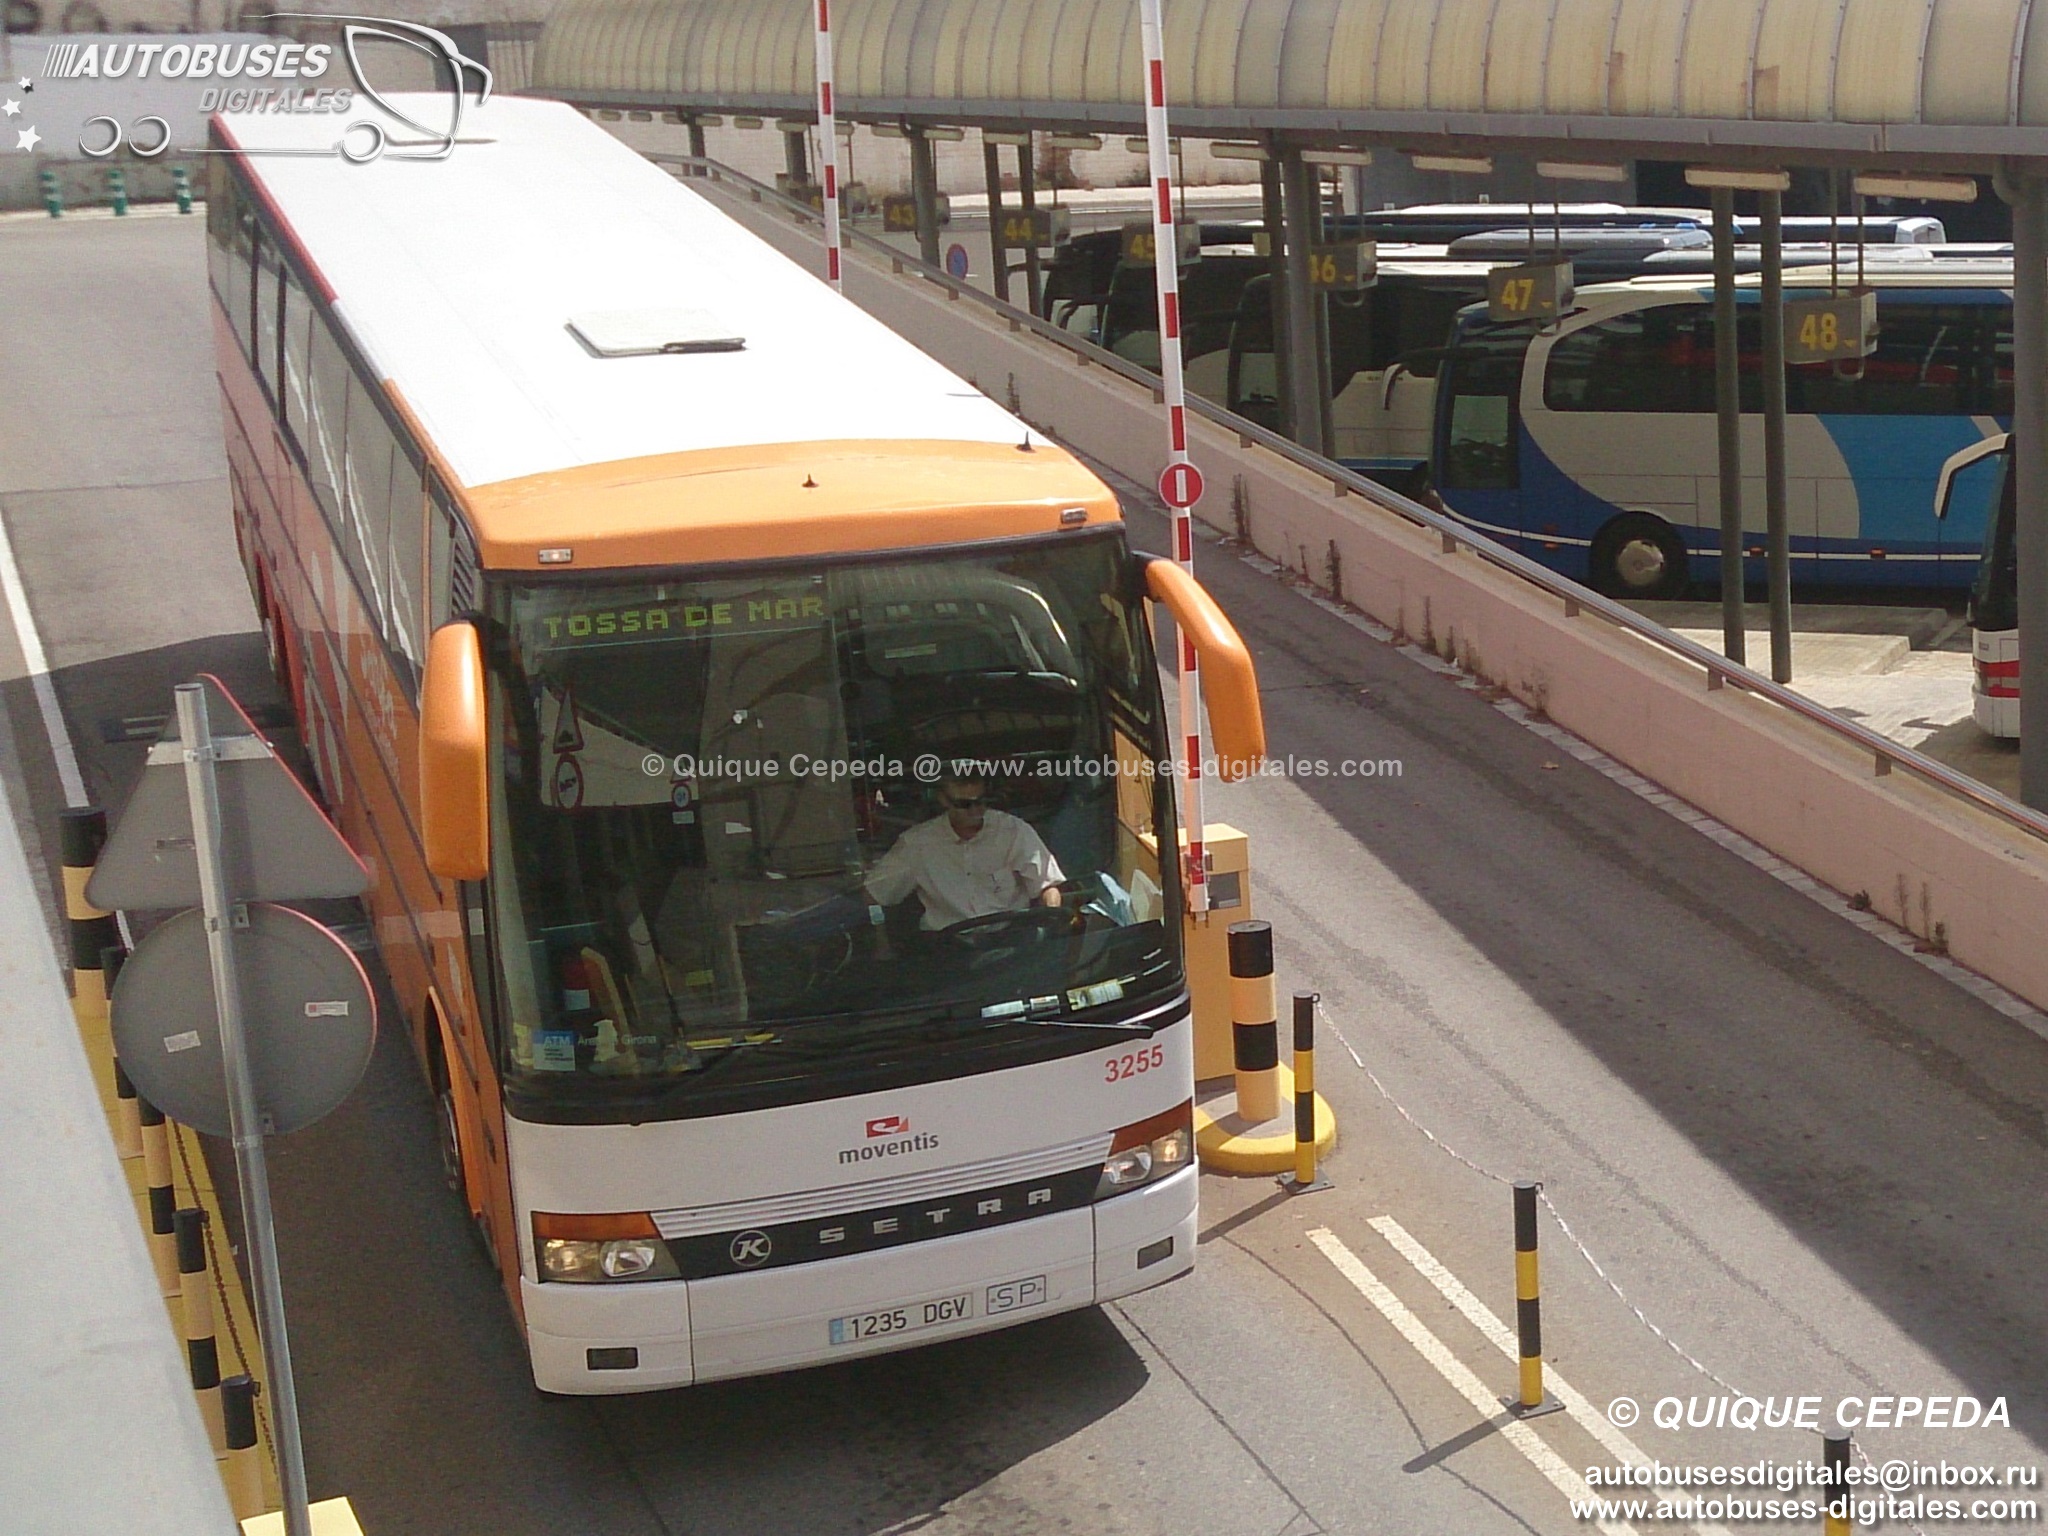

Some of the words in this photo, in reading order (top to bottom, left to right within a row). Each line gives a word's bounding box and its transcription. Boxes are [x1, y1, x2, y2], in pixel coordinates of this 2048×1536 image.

[1502, 278, 1534, 311] 47
[1800, 312, 1838, 351] 48
[543, 607, 670, 639] TOSSA
[685, 603, 733, 628] DE
[748, 596, 825, 623] MAR
[1104, 1044, 1164, 1083] 3255
[838, 1131, 939, 1164] moventis
[820, 1188, 1051, 1244] SETRA
[851, 1310, 907, 1338] 1235
[923, 1296, 966, 1324] DGV
